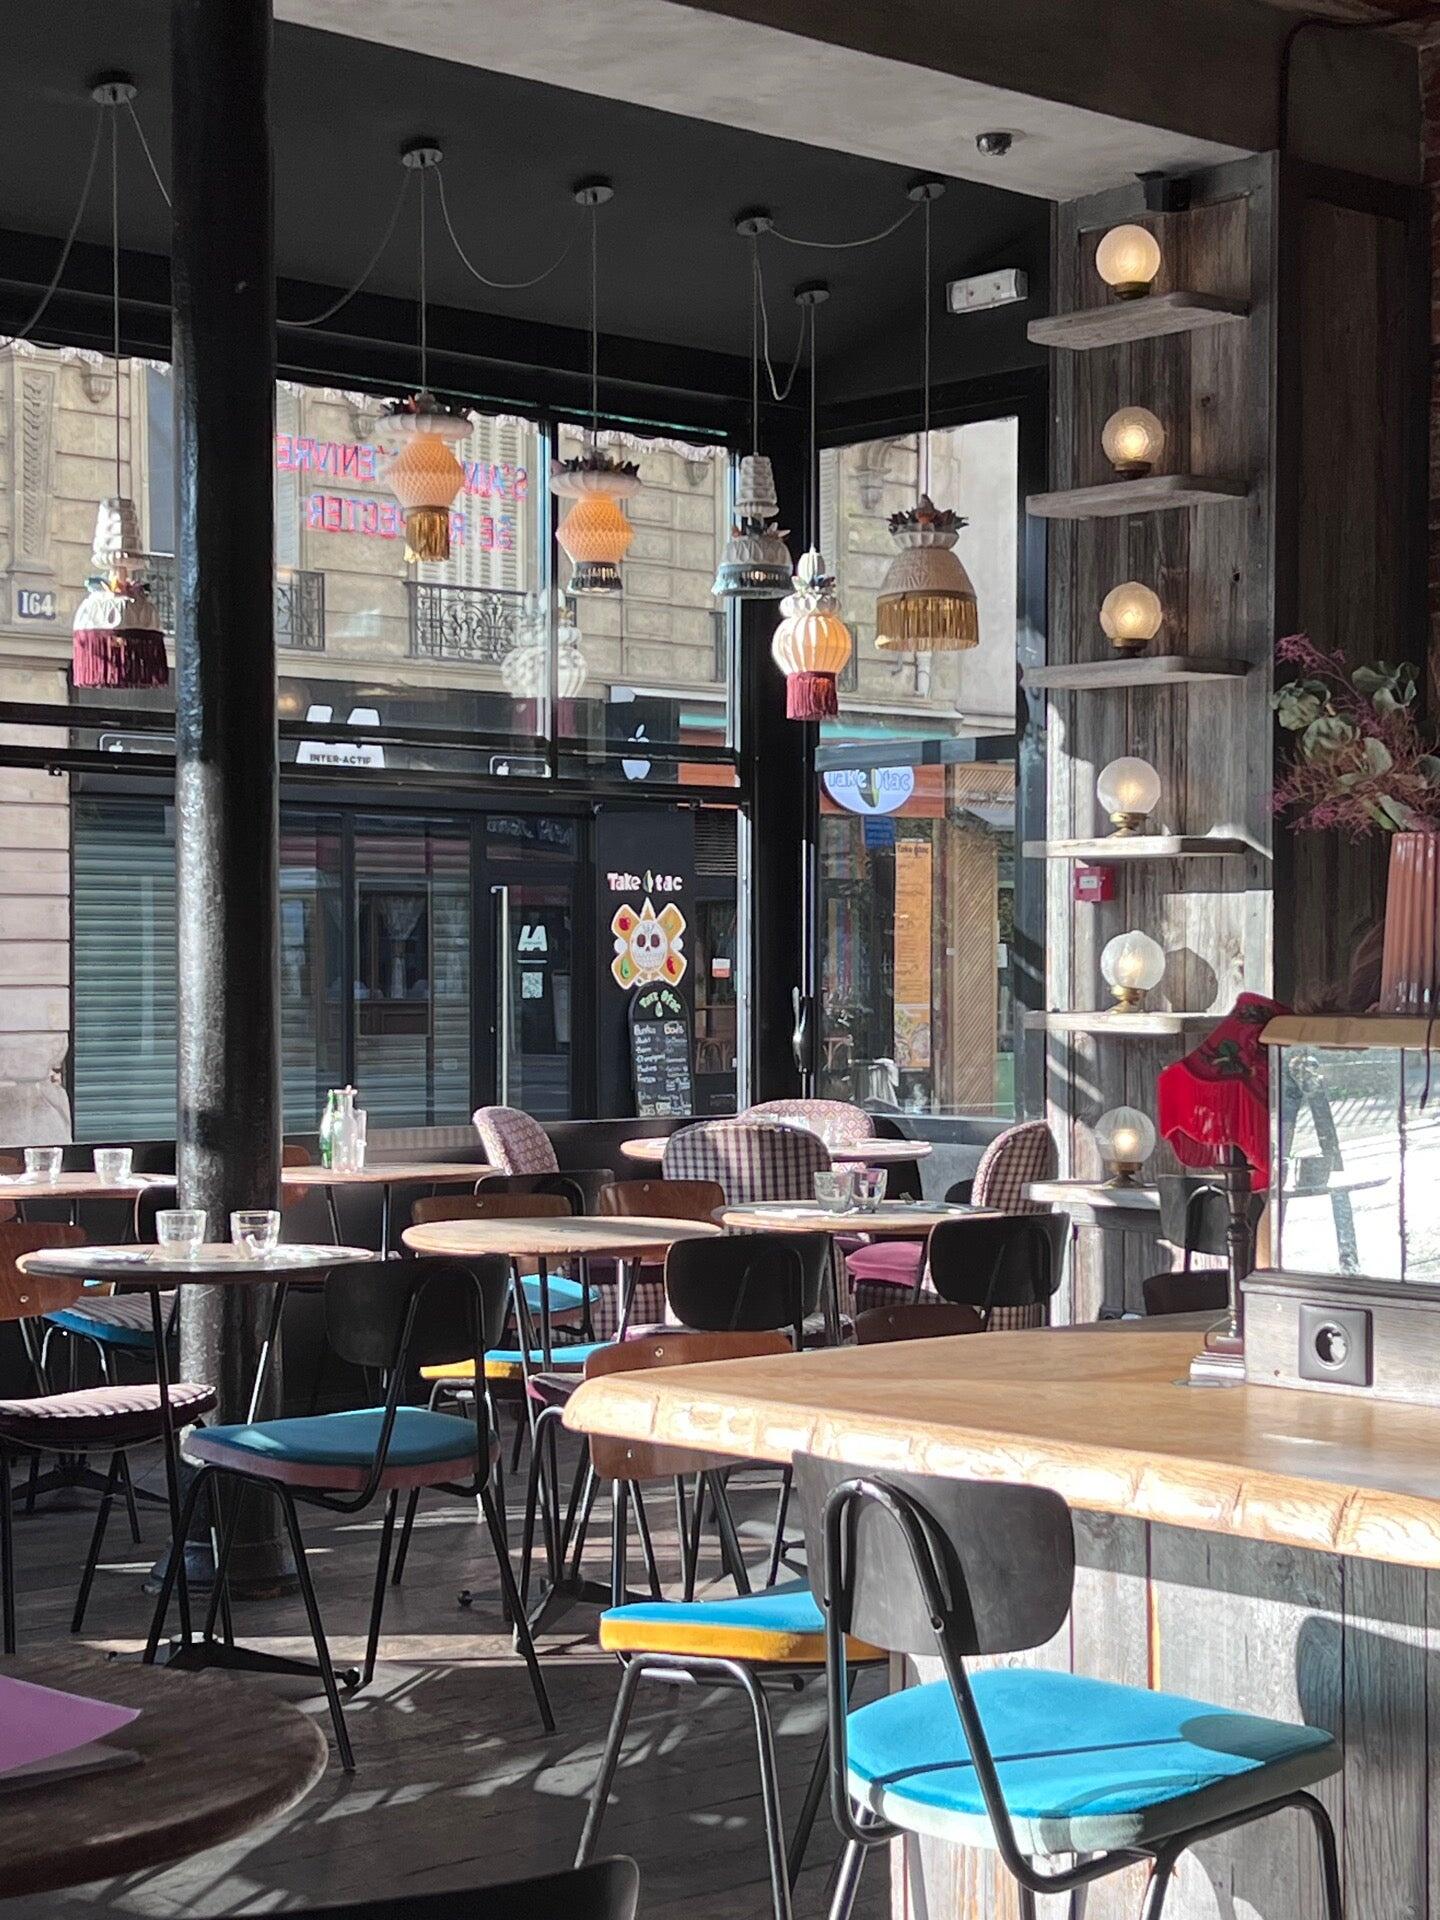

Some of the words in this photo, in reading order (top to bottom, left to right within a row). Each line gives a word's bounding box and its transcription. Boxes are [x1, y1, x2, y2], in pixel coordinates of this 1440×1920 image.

[21, 591, 54, 617] 164
[309, 753, 372, 765] INTER-ACTIF
[607, 872, 641, 891] Take
